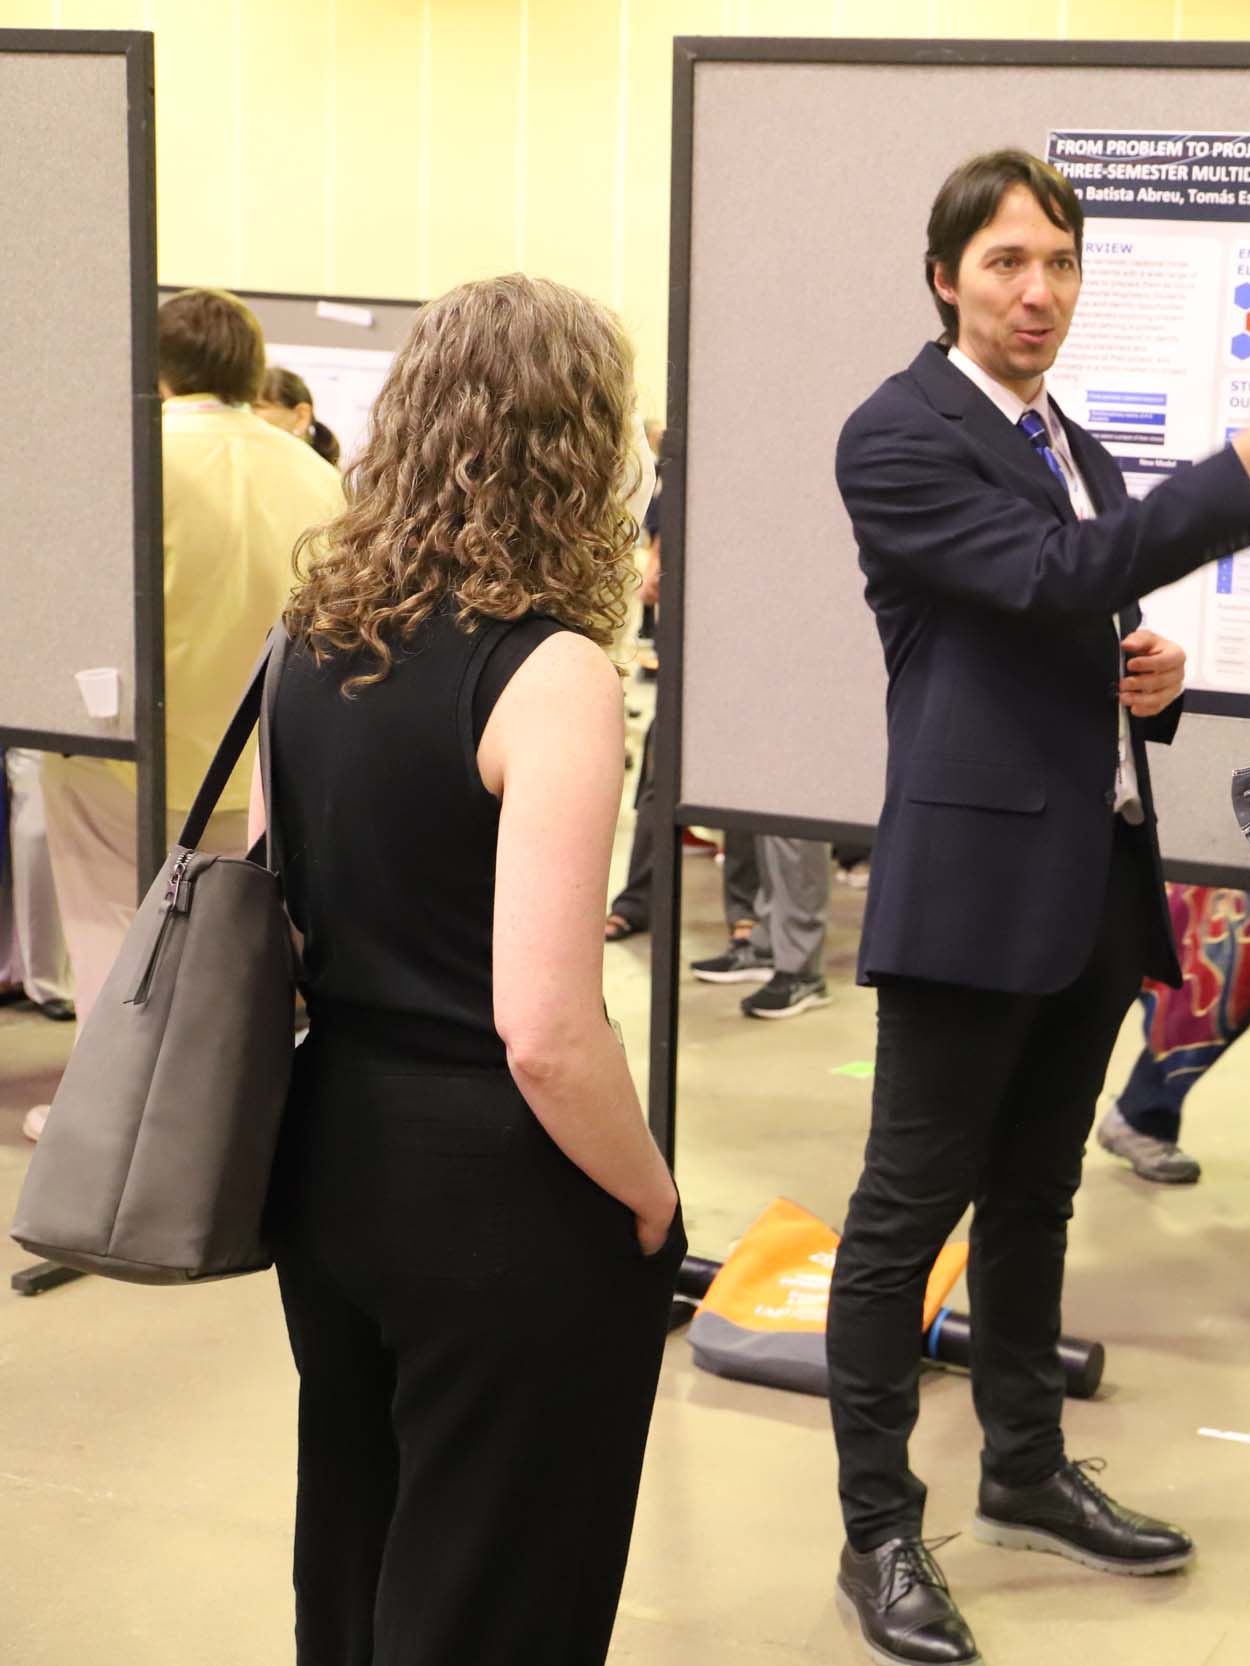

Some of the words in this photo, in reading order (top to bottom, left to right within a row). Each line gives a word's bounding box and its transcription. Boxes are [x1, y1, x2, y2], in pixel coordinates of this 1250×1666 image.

[1056, 139, 1104, 155] FROM
[1106, 140, 1183, 157] PROBLEM
[1187, 141, 1209, 157] TO
[1055, 162, 1188, 181] THREE-SEMESTER
[1086, 186, 1135, 201] Batista
[1137, 187, 1185, 206] Abreu,
[1187, 188, 1235, 205] Tomás
[1085, 242, 1134, 254] RVIEW
